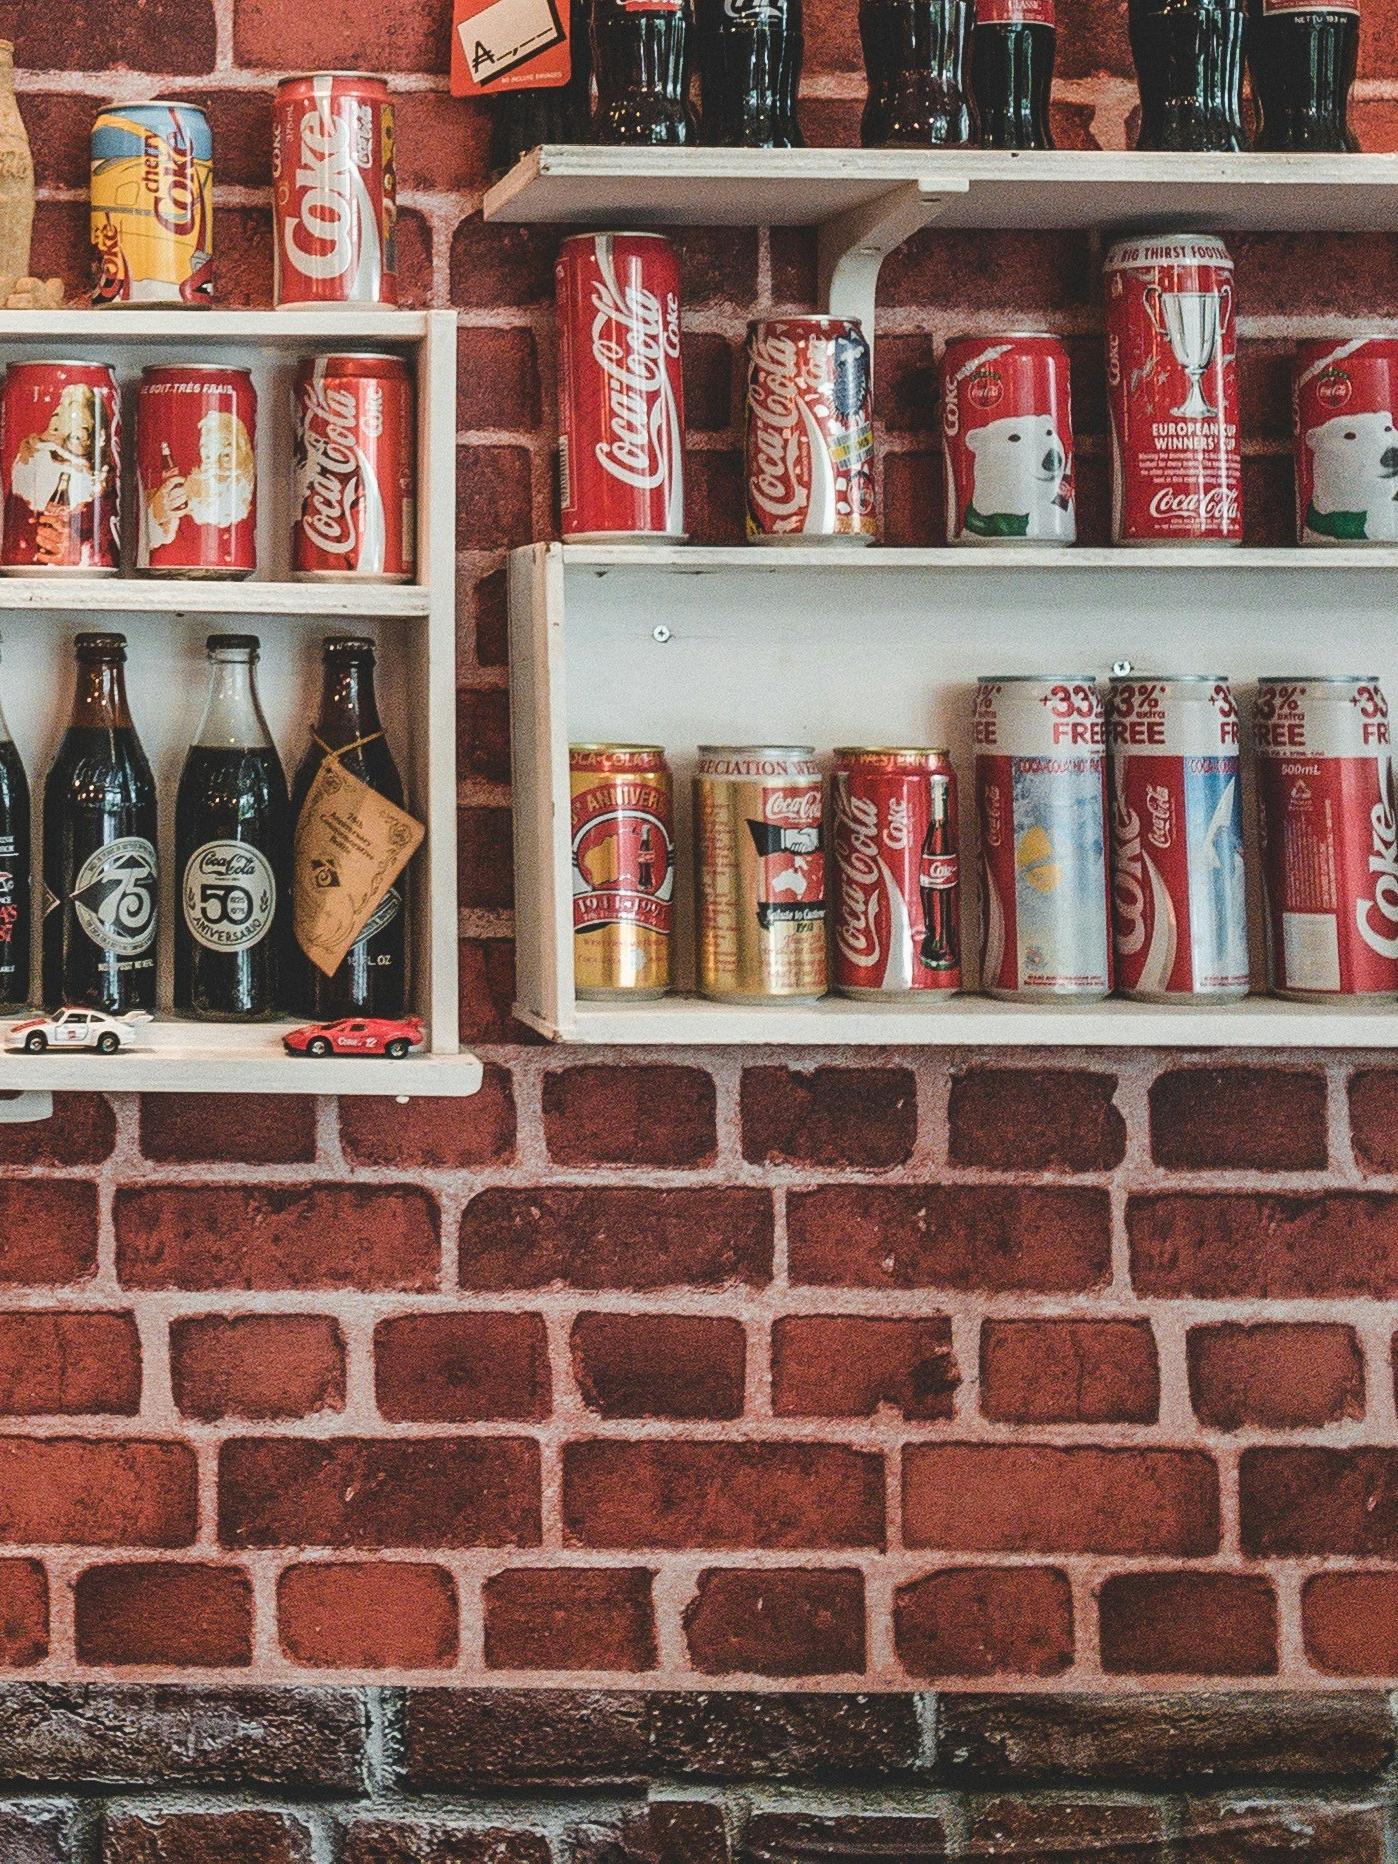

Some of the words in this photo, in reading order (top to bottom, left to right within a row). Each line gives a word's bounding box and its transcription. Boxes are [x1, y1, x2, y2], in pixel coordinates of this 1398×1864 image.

[142, 130, 160, 193] cherry
[154, 131, 195, 236] Coke
[284, 111, 351, 279] Coke
[1144, 245, 1186, 260] THIRST
[663, 292, 679, 358] Coke
[149, 383, 172, 394] BOIT
[591, 280, 664, 489] Coca-Cola
[361, 388, 383, 437] Coke
[749, 335, 799, 516] Coca-Cola
[1152, 422, 1219, 436] EUROPEAN
[303, 384, 357, 554] Coca-Cola
[1154, 436, 1218, 450] WINNERS'
[1149, 487, 1239, 518] Coca-Cola
[1135, 710, 1165, 719] extra
[883, 797, 906, 850] Coke
[1147, 785, 1171, 849] Coca-Cola
[199, 850, 256, 876] Coca-Cola
[834, 796, 880, 967] Coca-Cola
[1356, 801, 1398, 959] Coke
[97, 867, 151, 928] 75
[200, 883, 254, 926] 50
[192, 917, 262, 943] ANIVERSARIO
[377, 955, 392, 966] OZ
